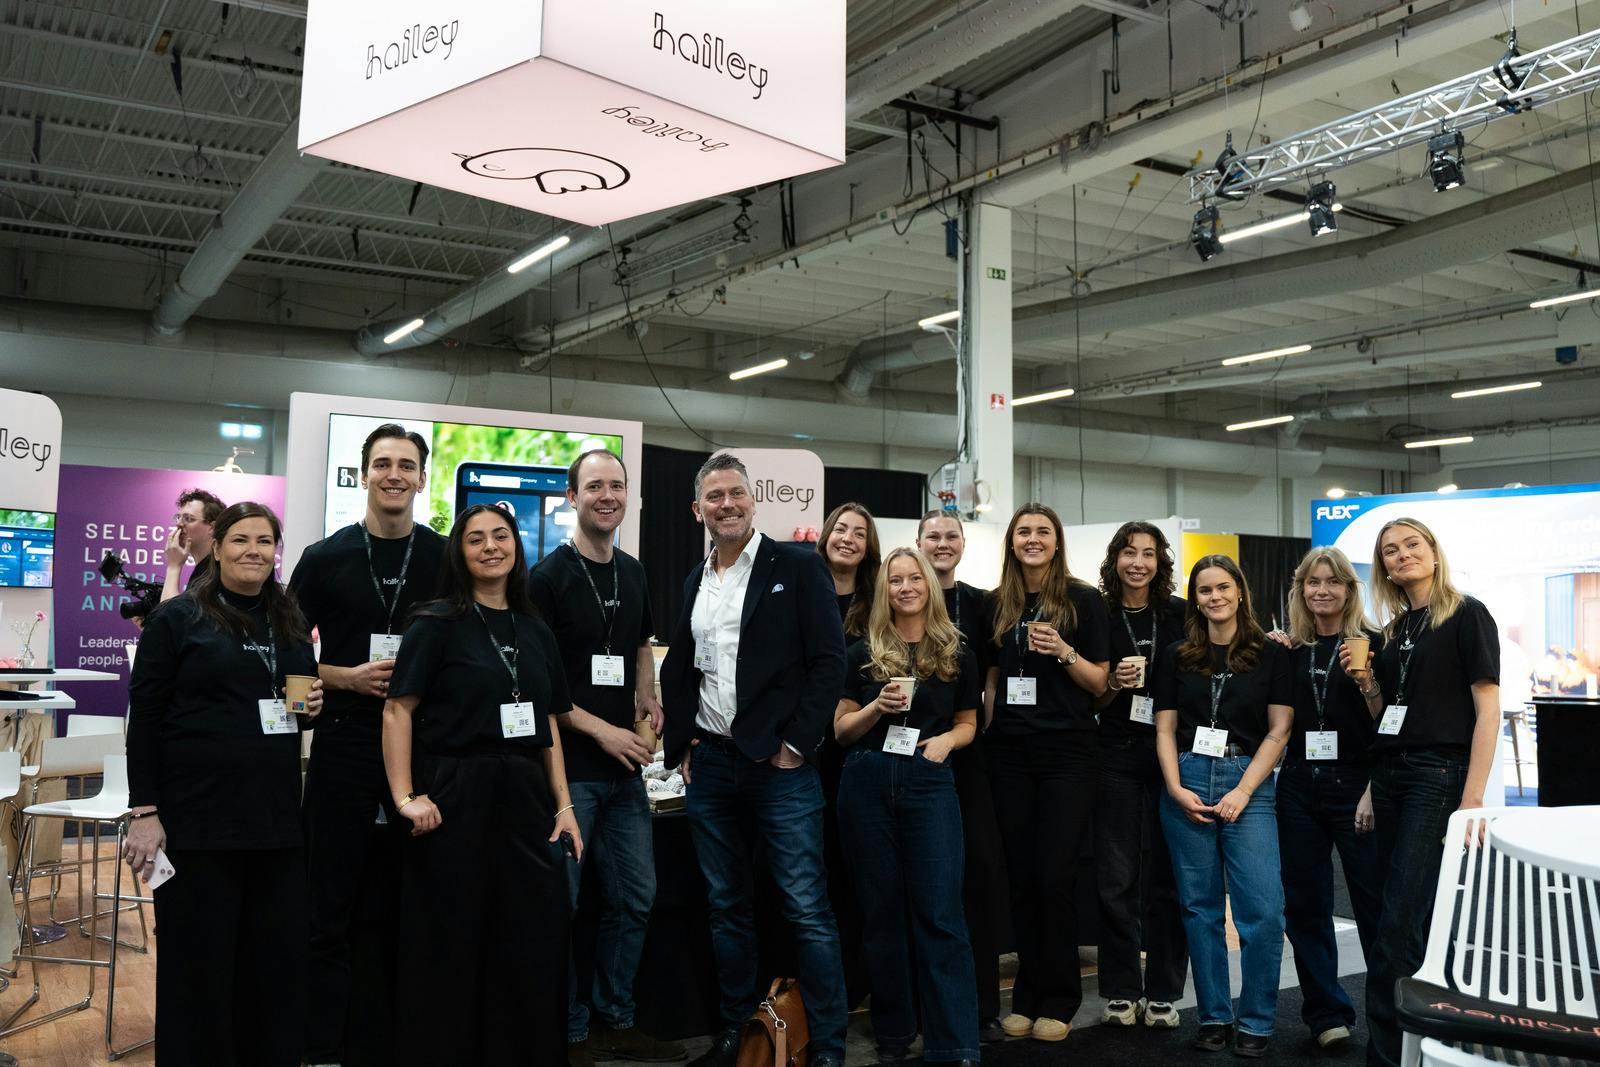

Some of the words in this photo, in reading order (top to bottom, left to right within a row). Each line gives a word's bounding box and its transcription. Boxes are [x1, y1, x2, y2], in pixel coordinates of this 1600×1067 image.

[366, 19, 459, 80] hailey
[654, 12, 768, 99] hailey
[601, 105, 730, 153] hailey
[1316, 504, 1360, 521] FLEX
